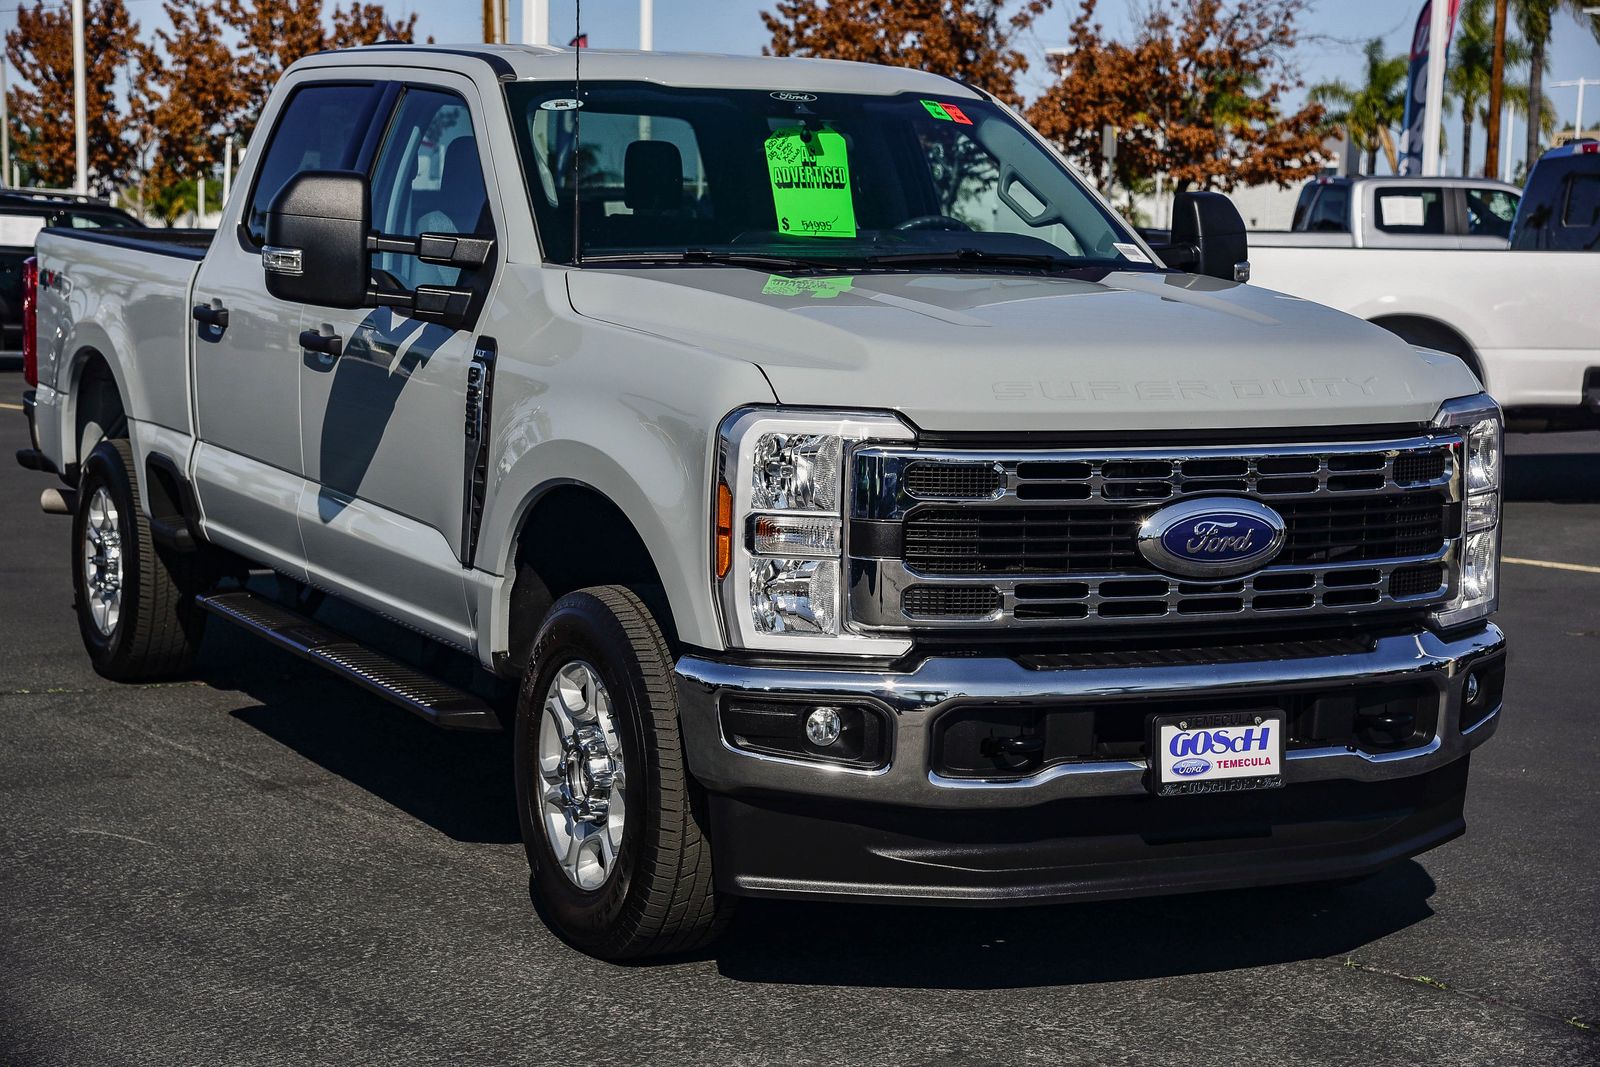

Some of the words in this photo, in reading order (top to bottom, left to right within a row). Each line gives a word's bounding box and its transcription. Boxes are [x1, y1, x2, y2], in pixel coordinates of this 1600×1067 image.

[779, 91, 810, 100] Ford
[800, 146, 817, 166] AS
[774, 166, 847, 189] ADVERTISED
[781, 217, 790, 231] $
[475, 349, 486, 358] XLT
[991, 378, 1219, 401] SUPER
[1229, 375, 1380, 400] DUTY
[1186, 521, 1255, 553] Ford
[1188, 712, 1255, 728] TEMECULA
[1178, 761, 1204, 774] Ford
[1216, 757, 1271, 769] TEMECULA
